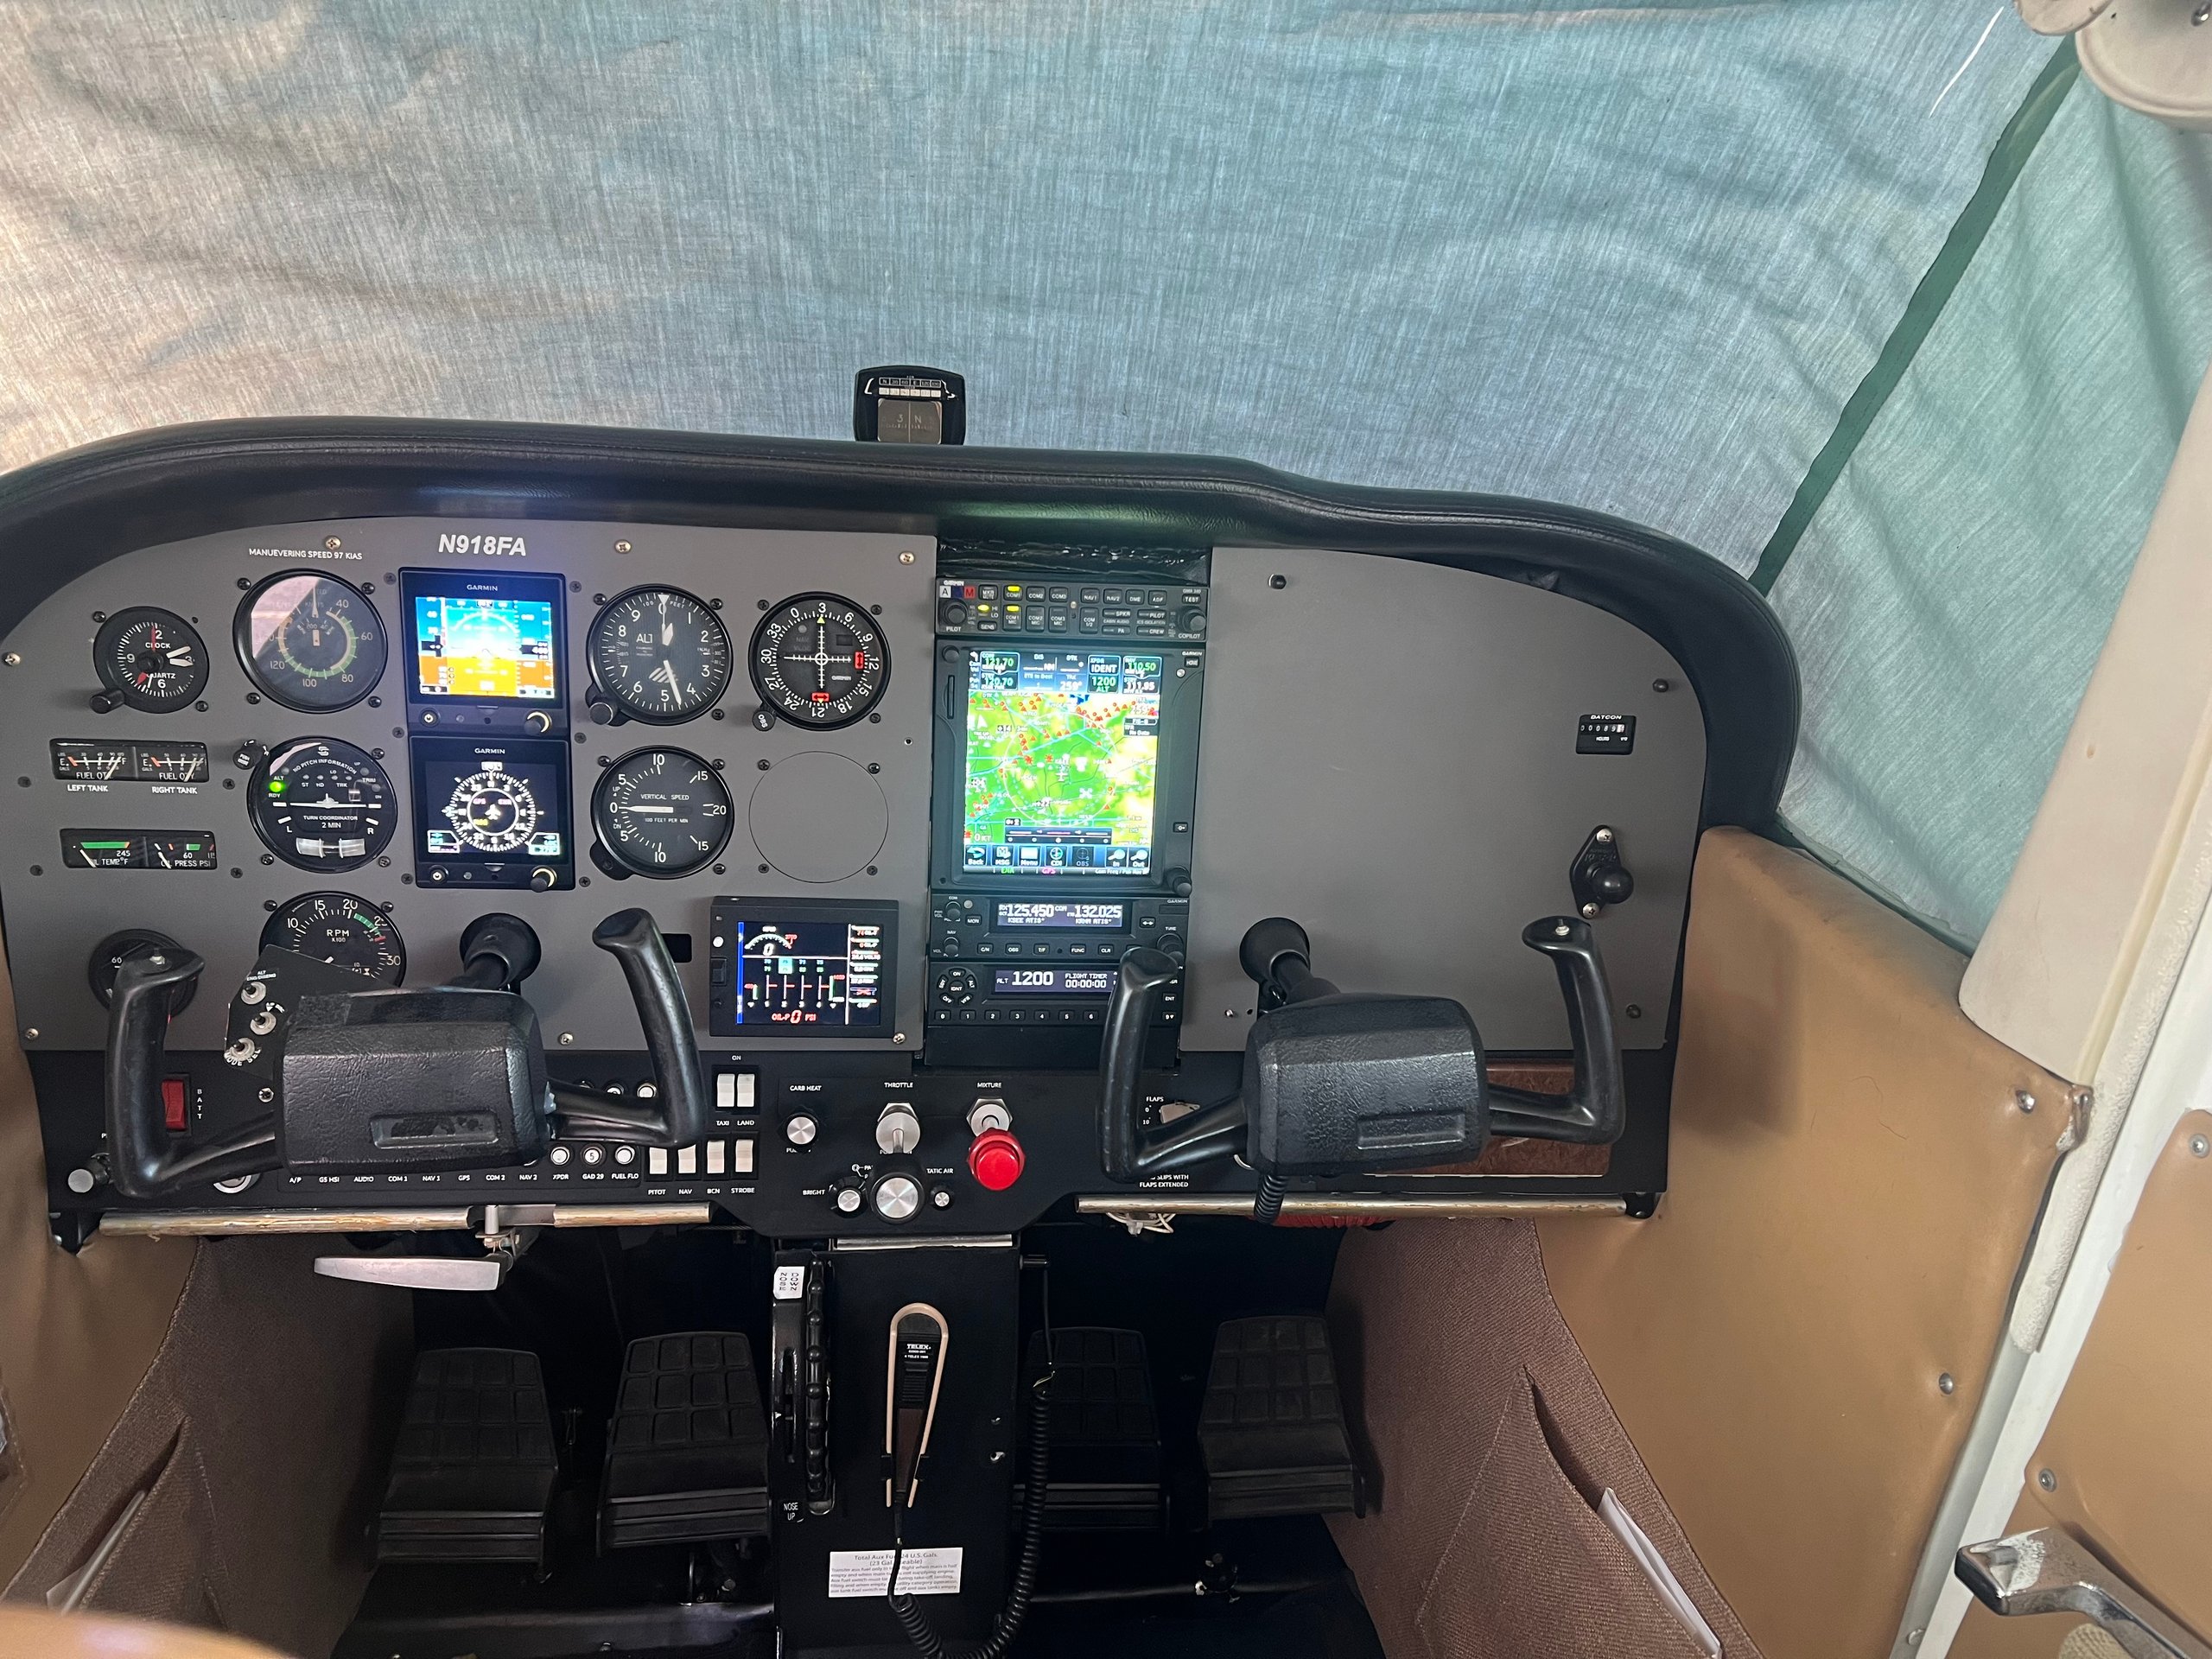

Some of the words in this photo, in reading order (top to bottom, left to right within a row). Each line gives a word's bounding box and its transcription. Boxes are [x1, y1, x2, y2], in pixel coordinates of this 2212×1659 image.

[439, 534, 526, 556] N918FA
[249, 548, 307, 558] MANUEVERING
[336, 600, 349, 608] 40
[819, 603, 826, 613] 3
[632, 610, 641, 622] 9
[845, 612, 855, 623] 6
[361, 632, 373, 641] 60
[619, 625, 626, 637] 8
[701, 630, 709, 642] 2
[767, 623, 782, 639] 33
[863, 633, 873, 642] 9
[127, 654, 135, 663] 9
[761, 649, 772, 664] 30
[270, 661, 285, 669] 120
[869, 657, 879, 671] 12
[1091, 664, 1117, 673] IDENT
[620, 665, 628, 677] 7
[701, 665, 710, 677] 3
[158, 679, 166, 689] 6
[633, 681, 642, 693] 6
[764, 677, 780, 690] 27
[1092, 677, 1116, 686] 1200
[687, 683, 696, 694] 4
[858, 683, 873, 697] 15
[661, 690, 669, 702] 5
[784, 696, 800, 711] 24
[837, 700, 853, 714] 18
[812, 707, 825, 718] 21
[653, 754, 665, 765] 10
[618, 774, 627, 785] 5
[698, 771, 708, 781] 15
[610, 802, 618, 814] 0
[713, 805, 726, 815] 20
[620, 831, 629, 842] 5
[699, 842, 709, 851] 15
[655, 852, 666, 863] 10
[315, 900, 325, 910] 15
[343, 899, 358, 909] 20
[287, 918, 299, 928] 10
[387, 956, 400, 966] 30
[1012, 971, 1054, 985] 1200
[1065, 979, 1106, 988] 00:00:00
[590, 1152, 595, 1160] 5
[784, 1503, 798, 1511] NOSE
